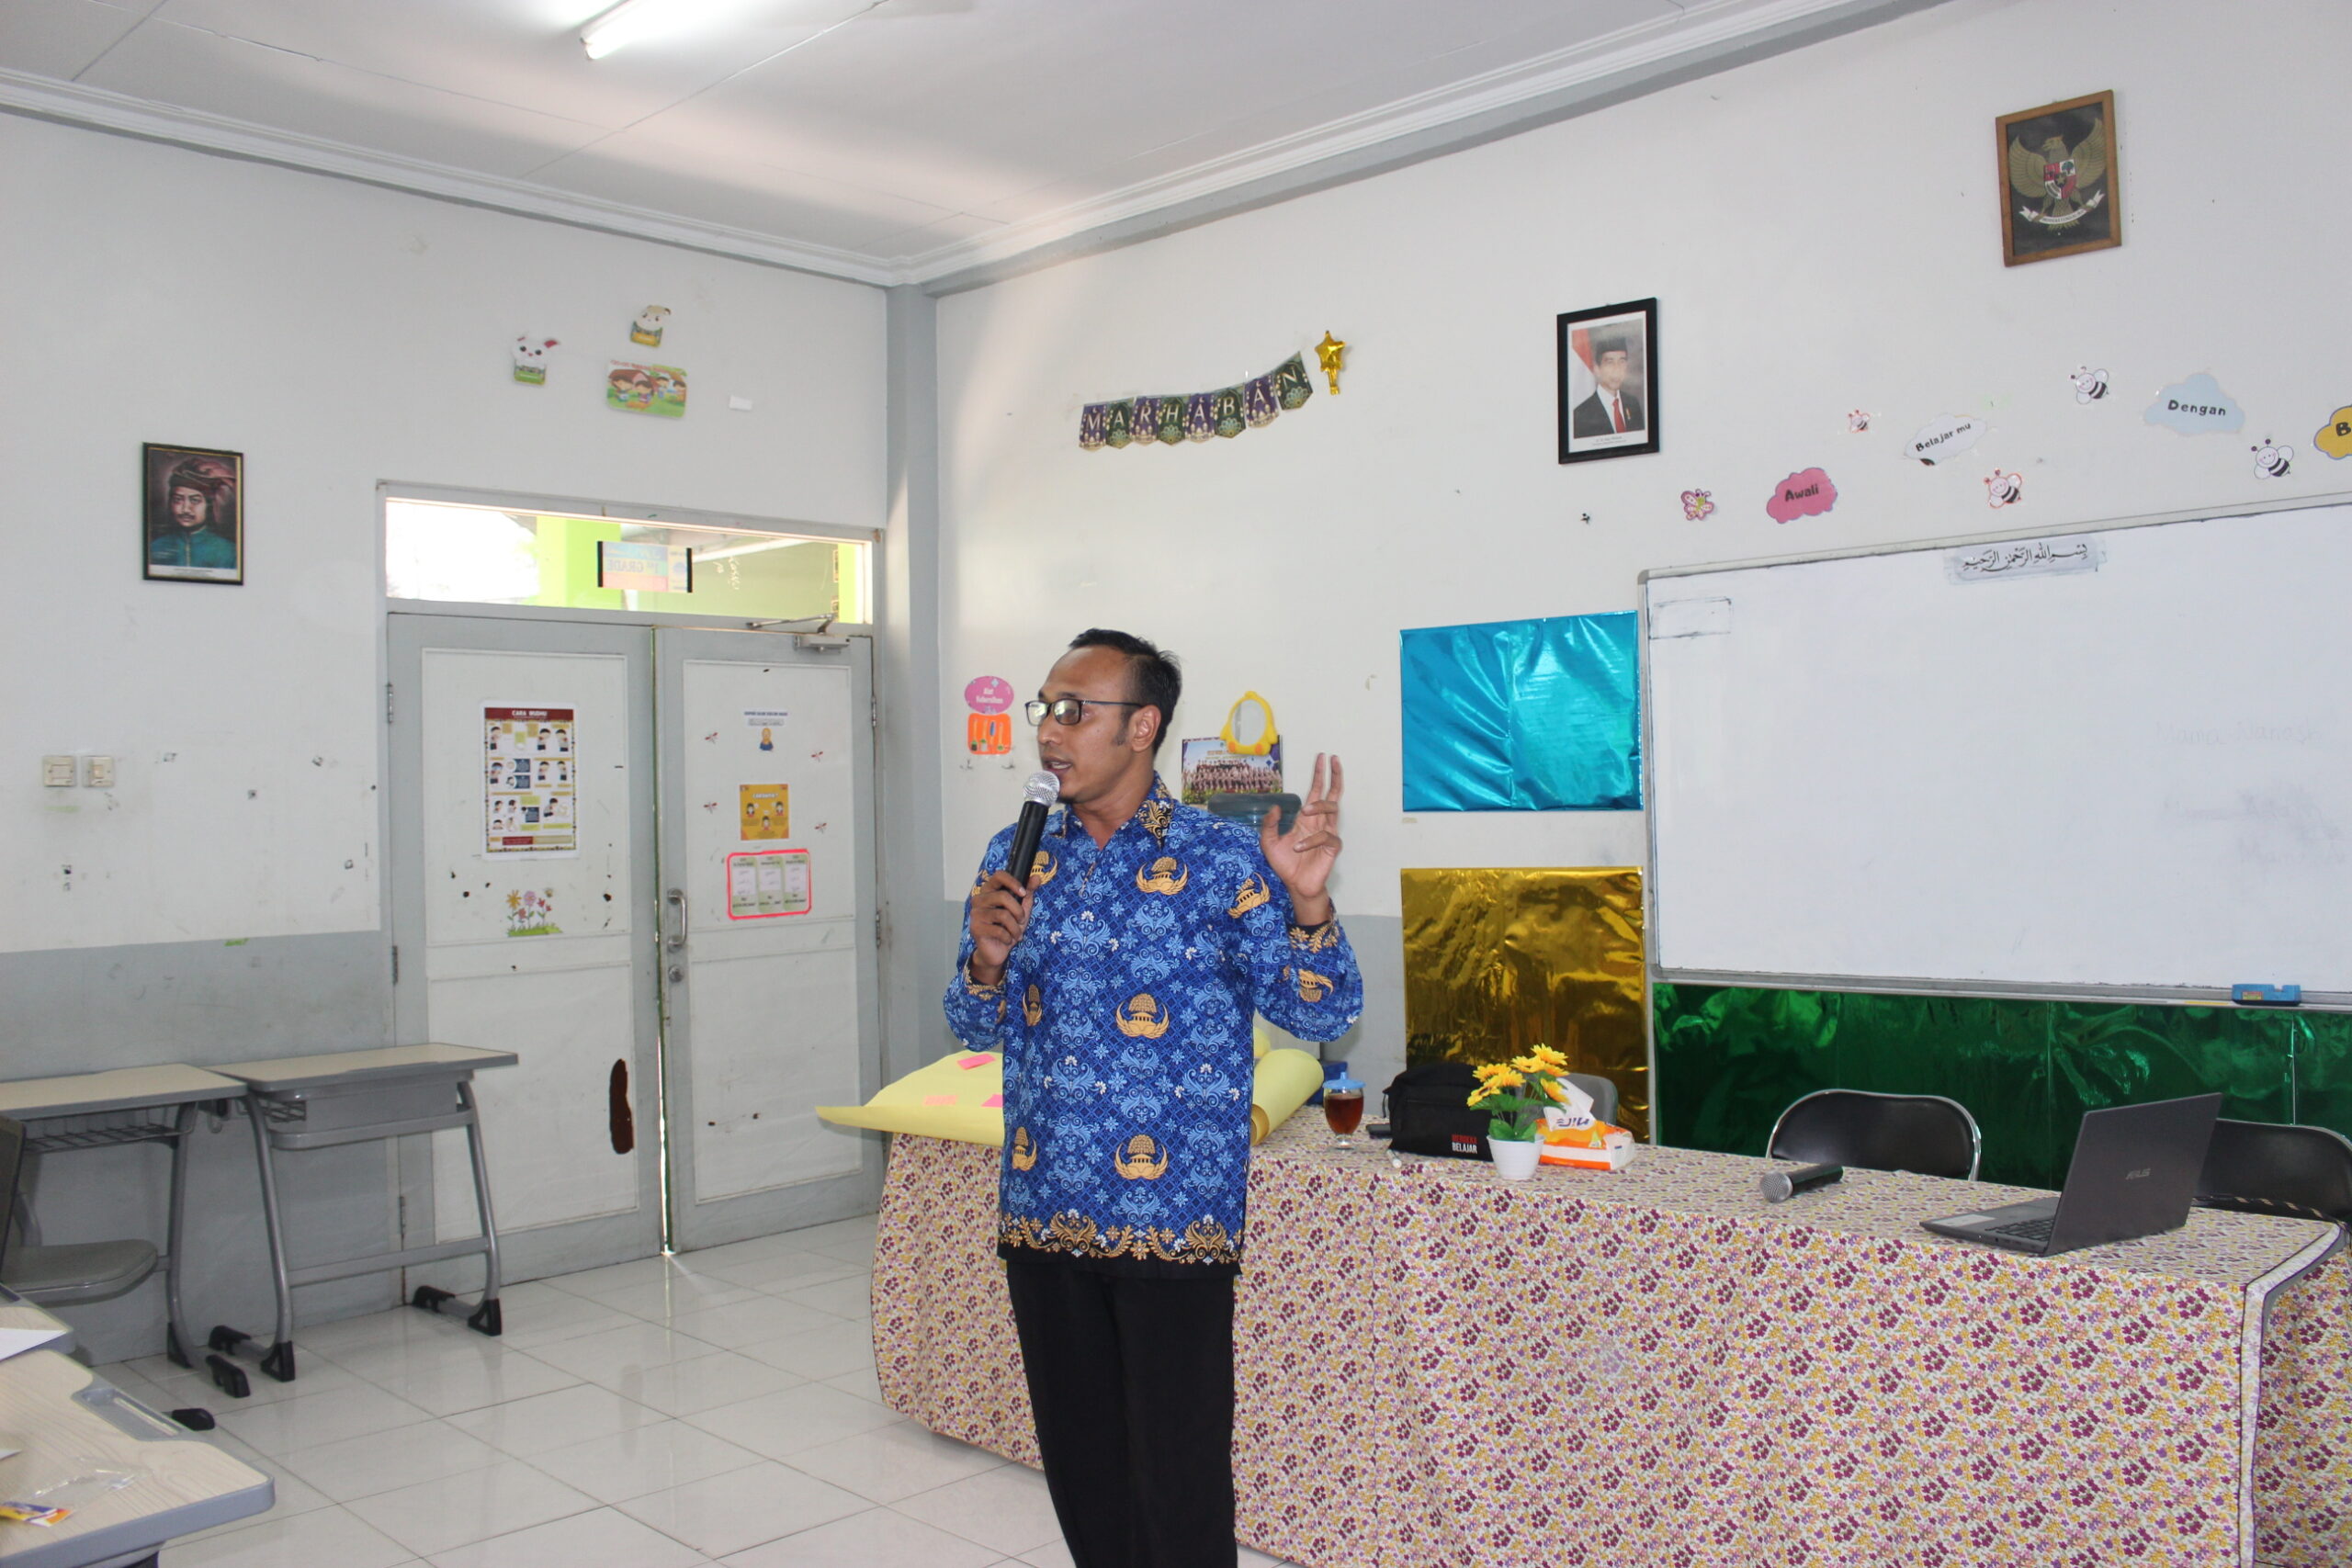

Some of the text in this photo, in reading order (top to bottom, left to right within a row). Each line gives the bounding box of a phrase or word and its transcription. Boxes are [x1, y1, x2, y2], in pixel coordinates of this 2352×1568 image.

[1085, 367, 1298, 431] MARHABAN
[2167, 400, 2227, 416] Dengan
[1916, 423, 1972, 452] Belajar mu
[1785, 483, 1819, 502] Awali
[1452, 1142, 1477, 1154] BELAJAR
[2125, 1168, 2152, 1180] ASUS
